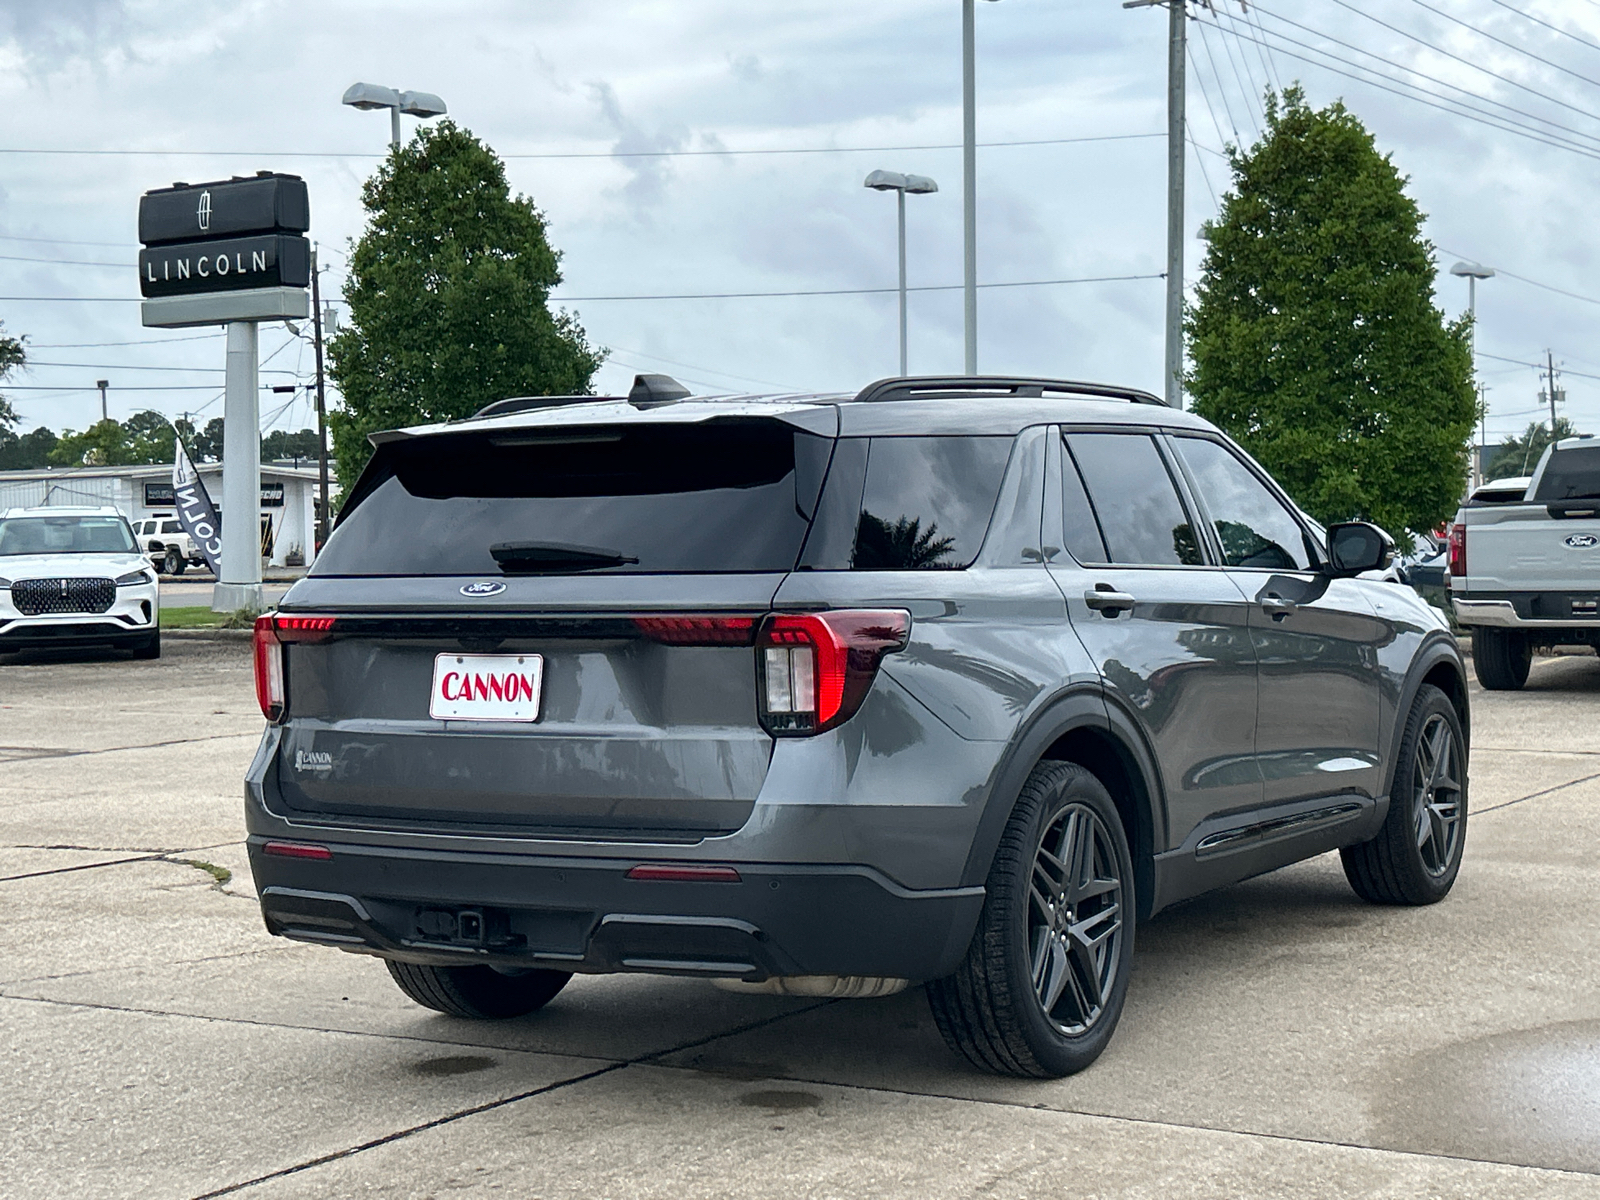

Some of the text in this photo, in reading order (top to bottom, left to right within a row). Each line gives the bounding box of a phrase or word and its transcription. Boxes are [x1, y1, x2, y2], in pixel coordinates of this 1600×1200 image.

[148, 250, 266, 282] LINCOLN
[442, 671, 535, 702] CANNON
[303, 751, 332, 764] CANNON
